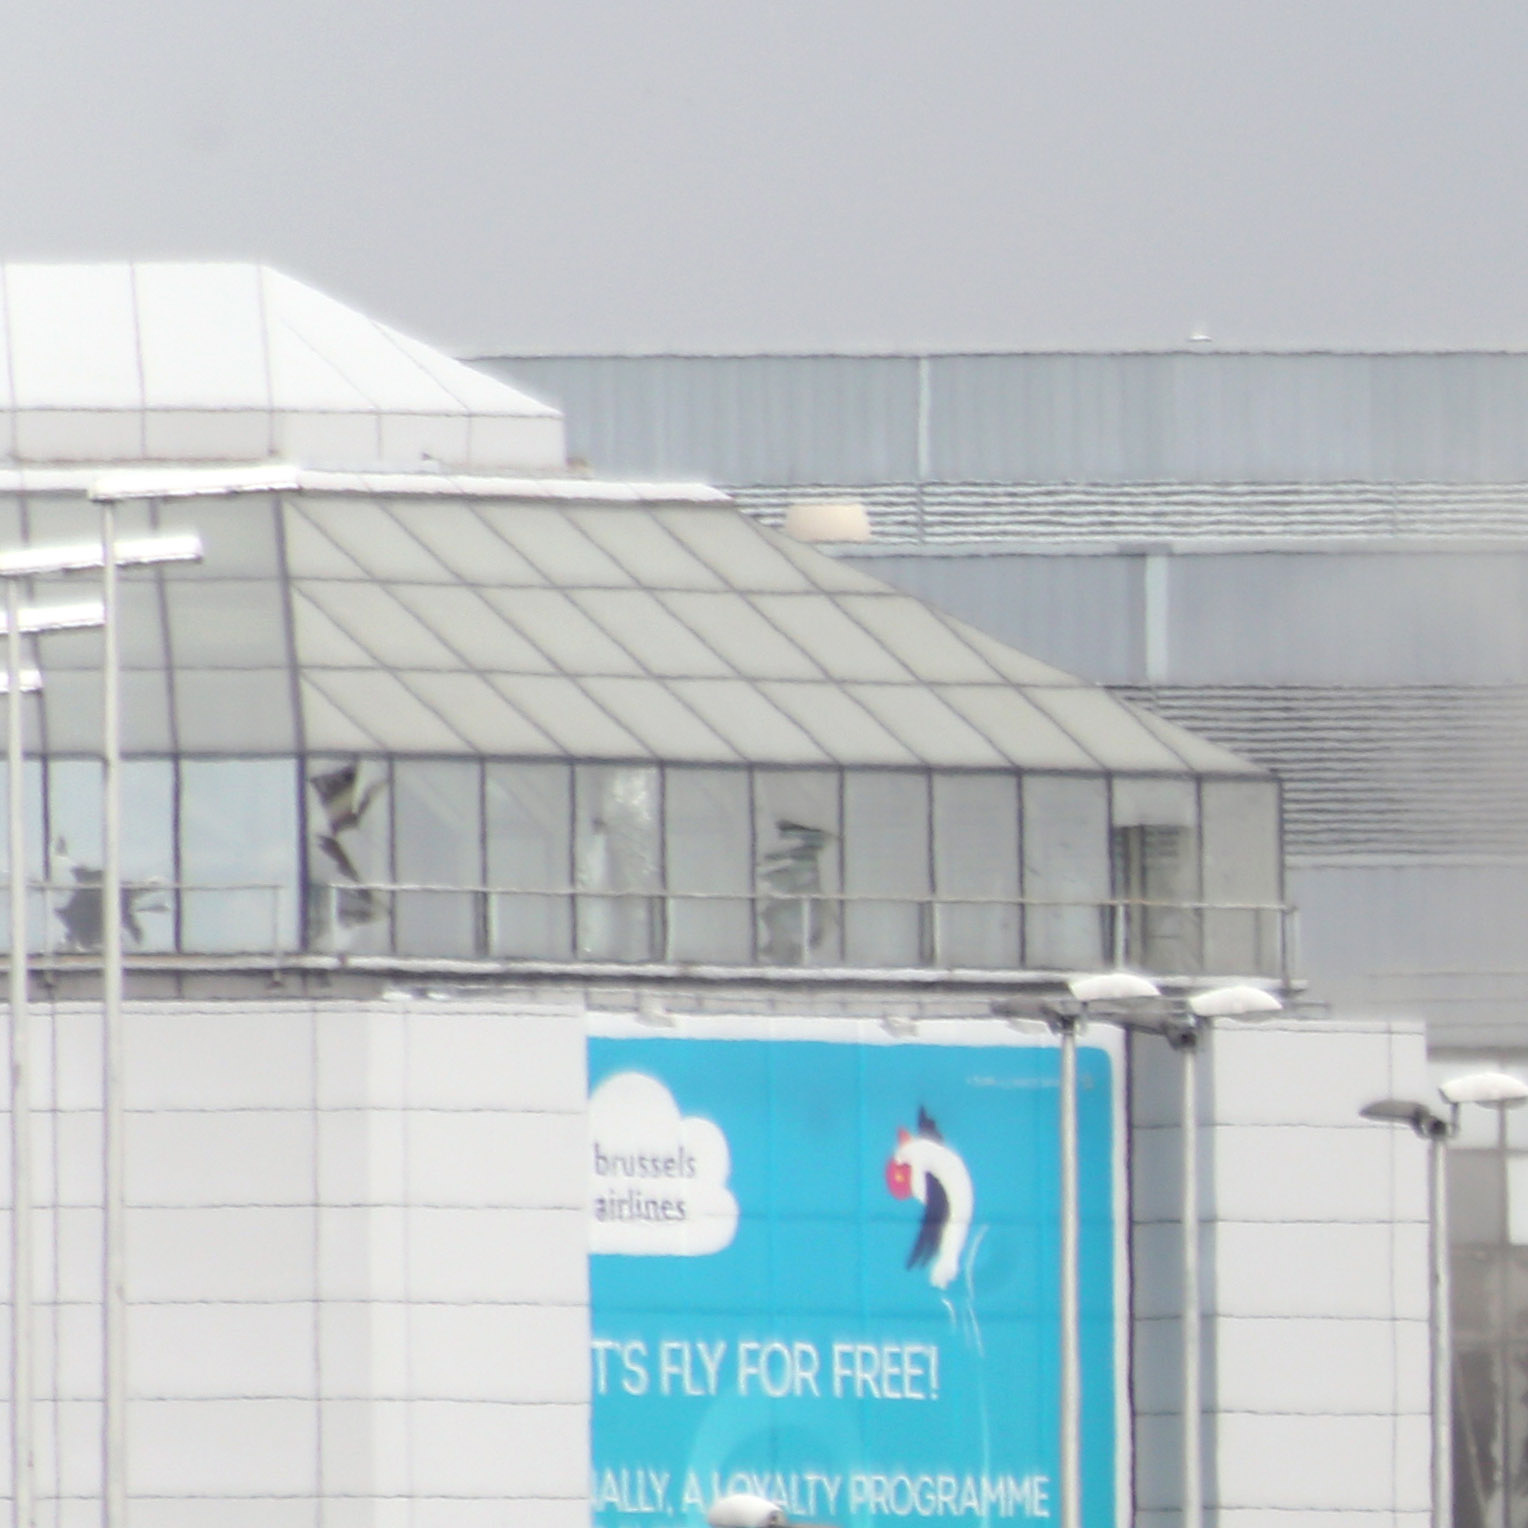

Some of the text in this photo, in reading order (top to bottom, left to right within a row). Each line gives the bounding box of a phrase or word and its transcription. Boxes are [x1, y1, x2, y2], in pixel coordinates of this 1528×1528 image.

[594, 1142, 697, 1178] brussels
[594, 1188, 687, 1221] airlines
[661, 1341, 726, 1396] FLY
[738, 1342, 820, 1398] FOR
[832, 1343, 939, 1400] FREE!
[592, 1467, 673, 1516] ALLY,
[681, 1471, 706, 1515] A
[851, 1473, 1051, 1518] PROGRAMME
